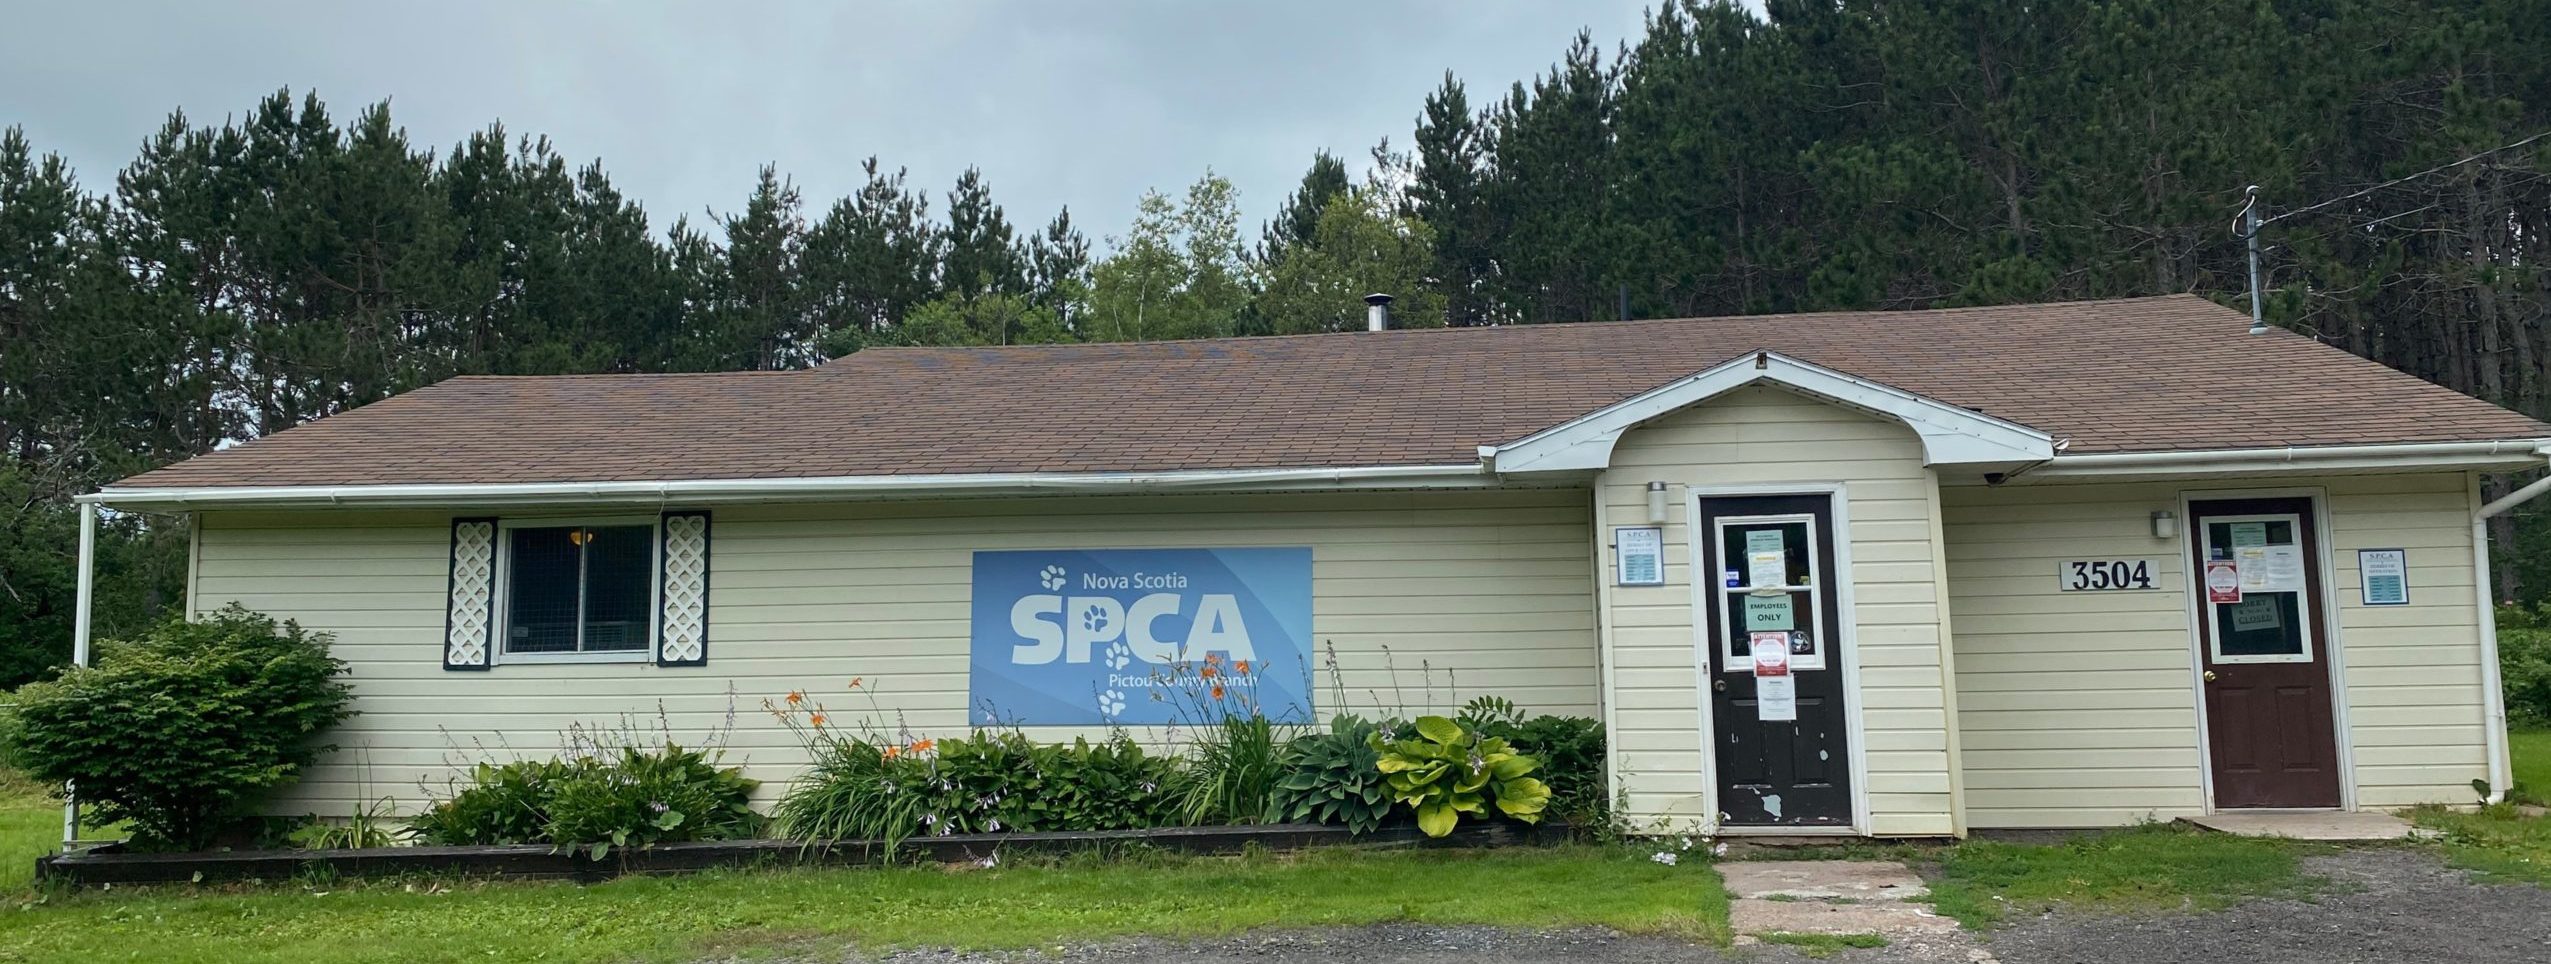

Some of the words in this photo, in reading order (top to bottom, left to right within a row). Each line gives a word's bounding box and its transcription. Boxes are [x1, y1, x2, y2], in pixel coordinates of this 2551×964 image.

[1083, 572, 1129, 589] Nova
[1133, 571, 1188, 589] Scotia
[2072, 560, 2151, 589] 3504
[1757, 613, 1782, 622] ONLY
[1011, 593, 1257, 665] SPCA
[1109, 673, 1153, 688] Pictou
